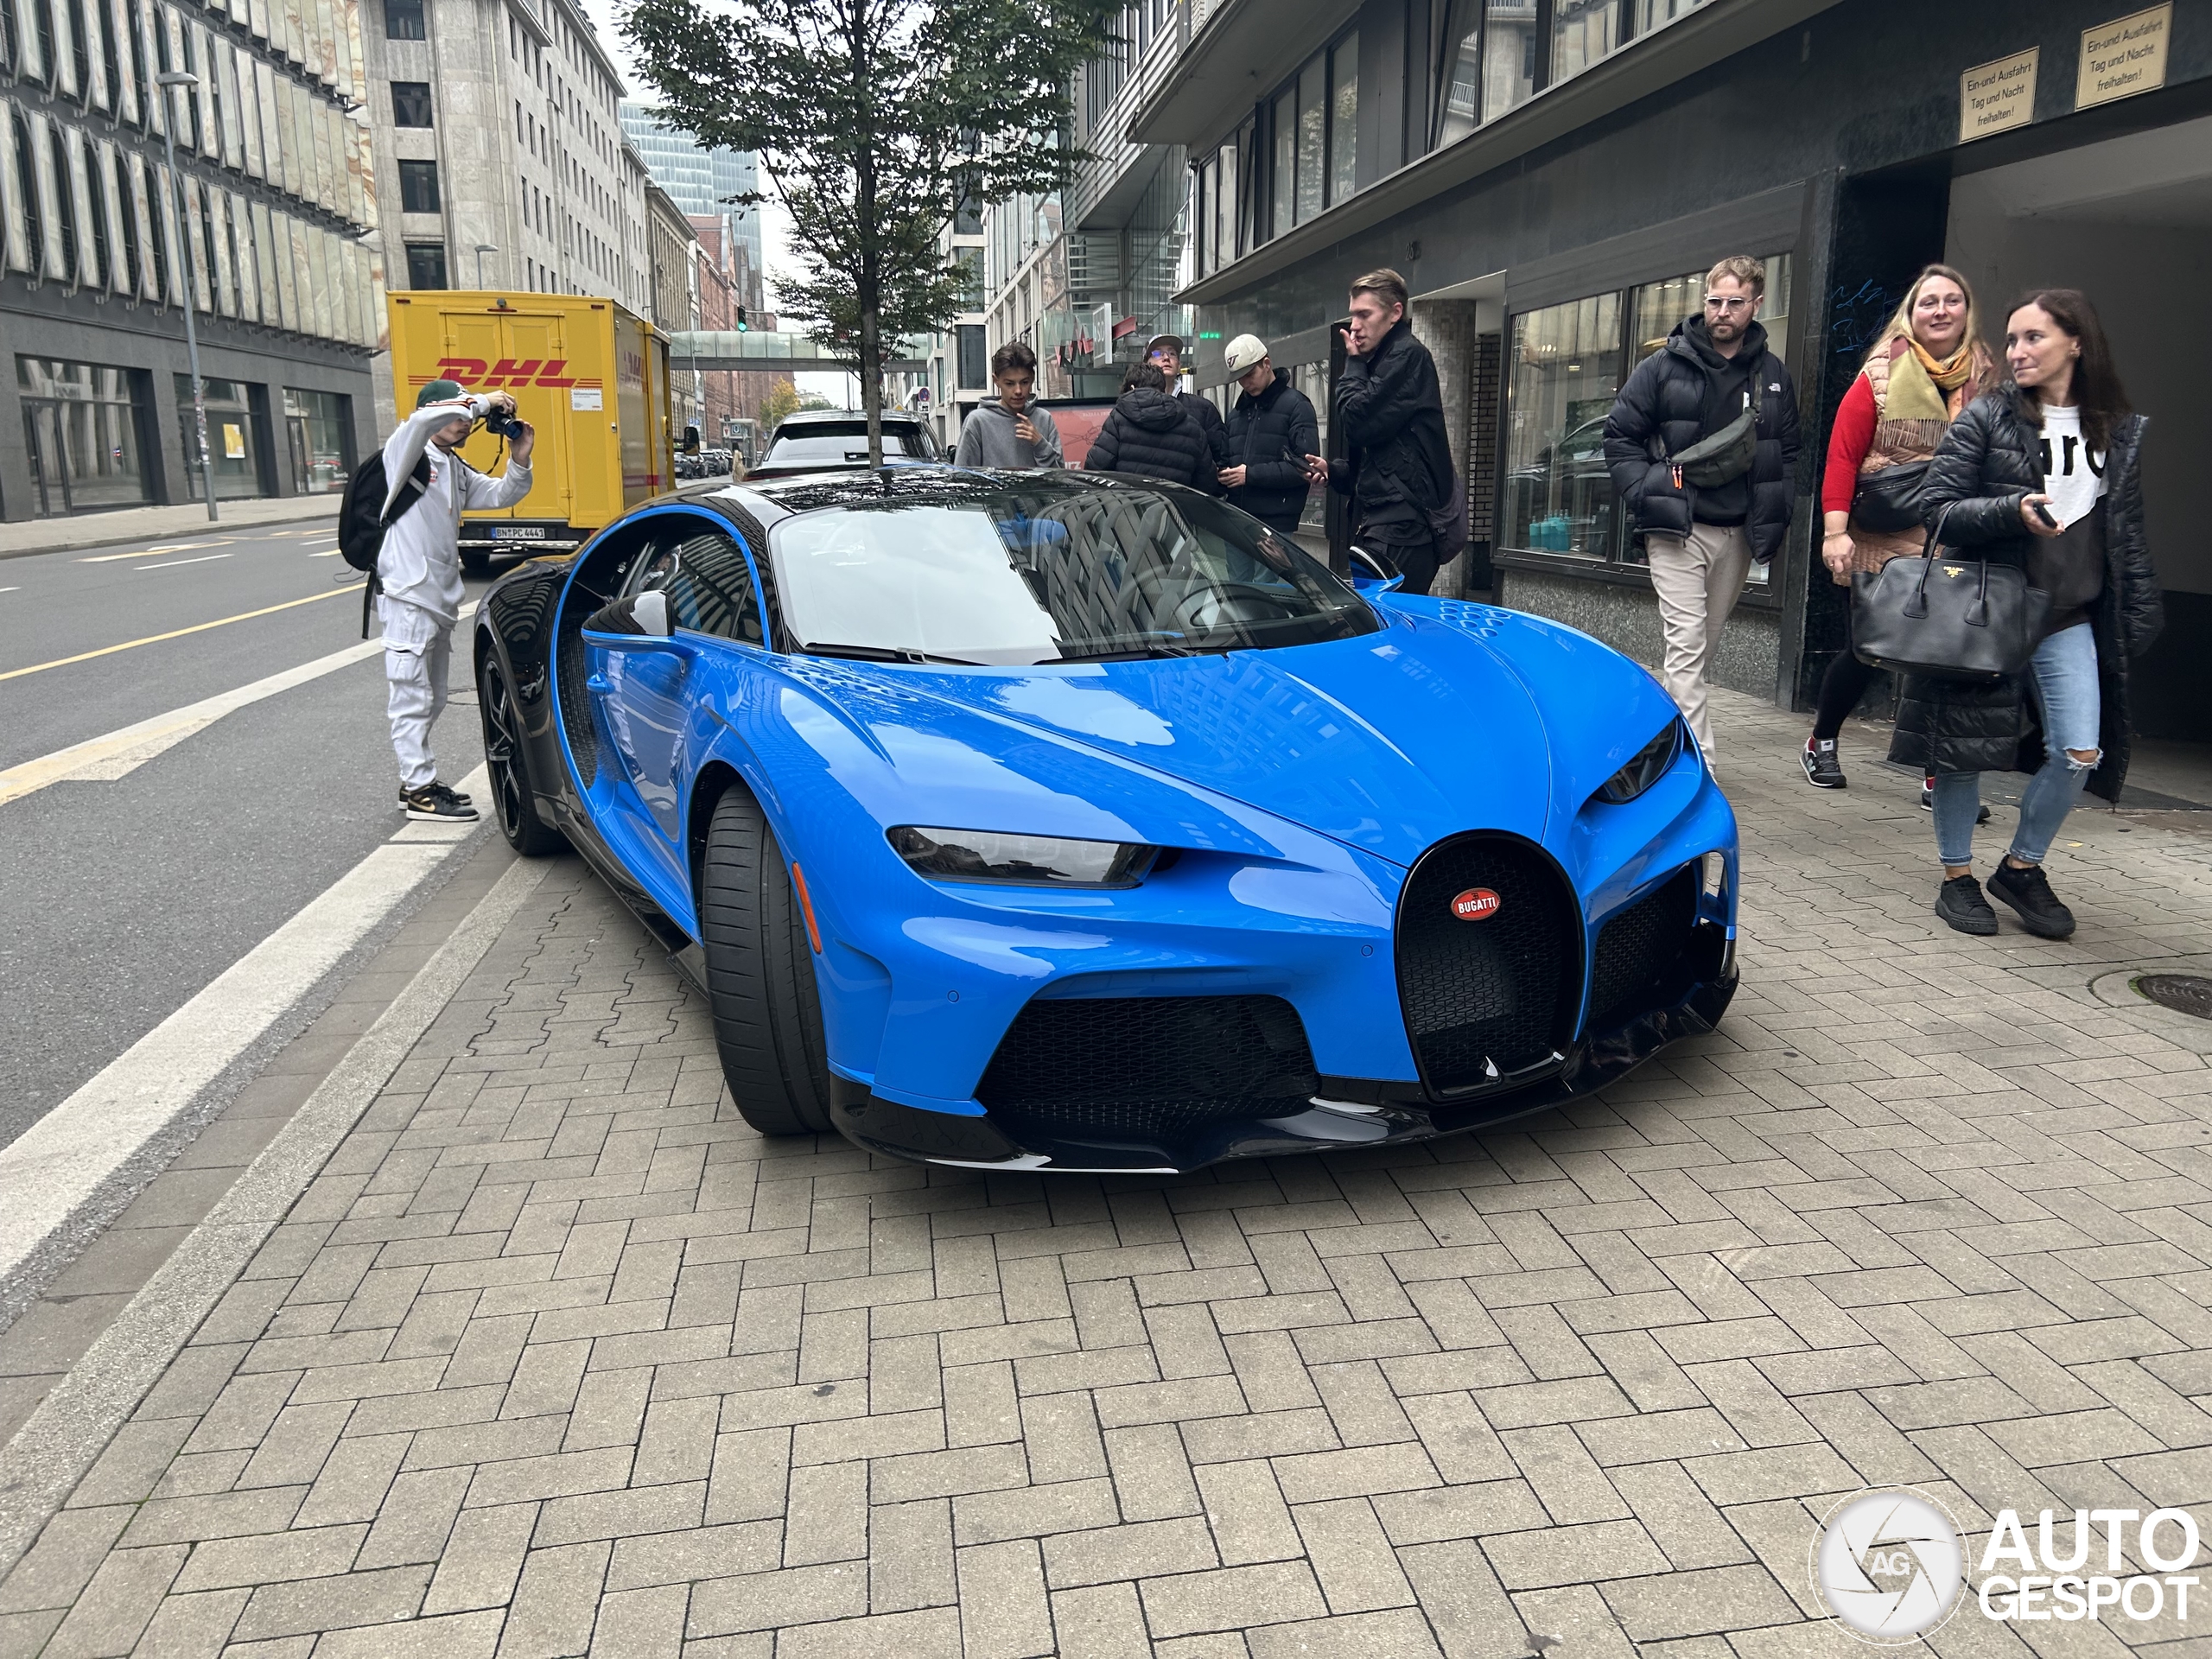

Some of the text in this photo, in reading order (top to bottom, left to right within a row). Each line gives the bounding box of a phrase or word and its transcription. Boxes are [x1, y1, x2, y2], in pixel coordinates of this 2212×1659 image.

[2121, 18, 2164, 42] Ausfahrt
[2090, 43, 2155, 73] Tag und Nacht
[1998, 61, 2032, 82] Ausfahrt
[2096, 67, 2143, 92] freihalten!
[1971, 83, 2025, 110] Tag und Nacht
[1976, 105, 2015, 127] freihalten!
[435, 357, 578, 388] DHL
[496, 528, 544, 537] BN PC 4441
[1458, 896, 1497, 914] BUGATTI
